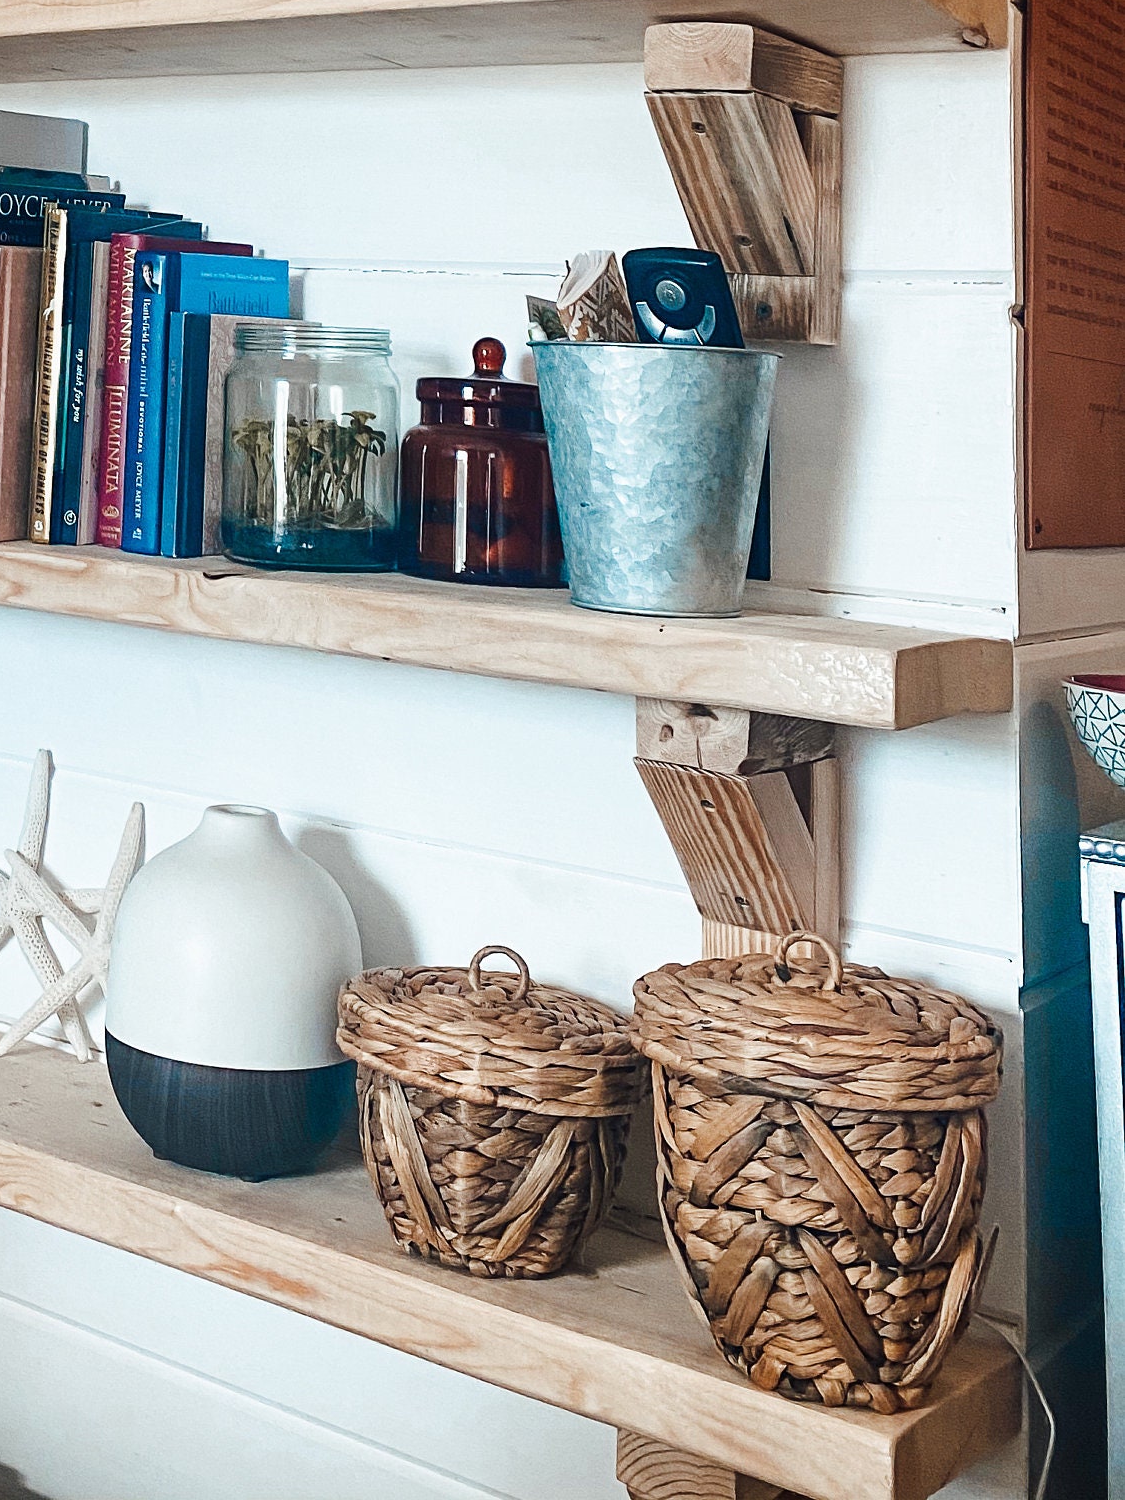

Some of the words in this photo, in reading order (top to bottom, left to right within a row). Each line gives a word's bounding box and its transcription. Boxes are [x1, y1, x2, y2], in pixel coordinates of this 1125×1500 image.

[118, 247, 137, 364] MARIANNE
[208, 290, 269, 316] Battlefield
[141, 298, 152, 343] Battlefield
[42, 335, 53, 380] UNICORN
[74, 348, 83, 360] my
[74, 361, 85, 387] wish
[41, 398, 50, 406] A
[43, 385, 52, 395] IN
[73, 388, 84, 403] for
[72, 404, 81, 423] you
[39, 410, 50, 445] WORLD
[106, 385, 126, 494] ILLUMINATA
[38, 450, 48, 463] OF
[136, 461, 144, 487] JOYCE
[35, 467, 47, 515] DONKEYS
[134, 488, 142, 519] MEYER
